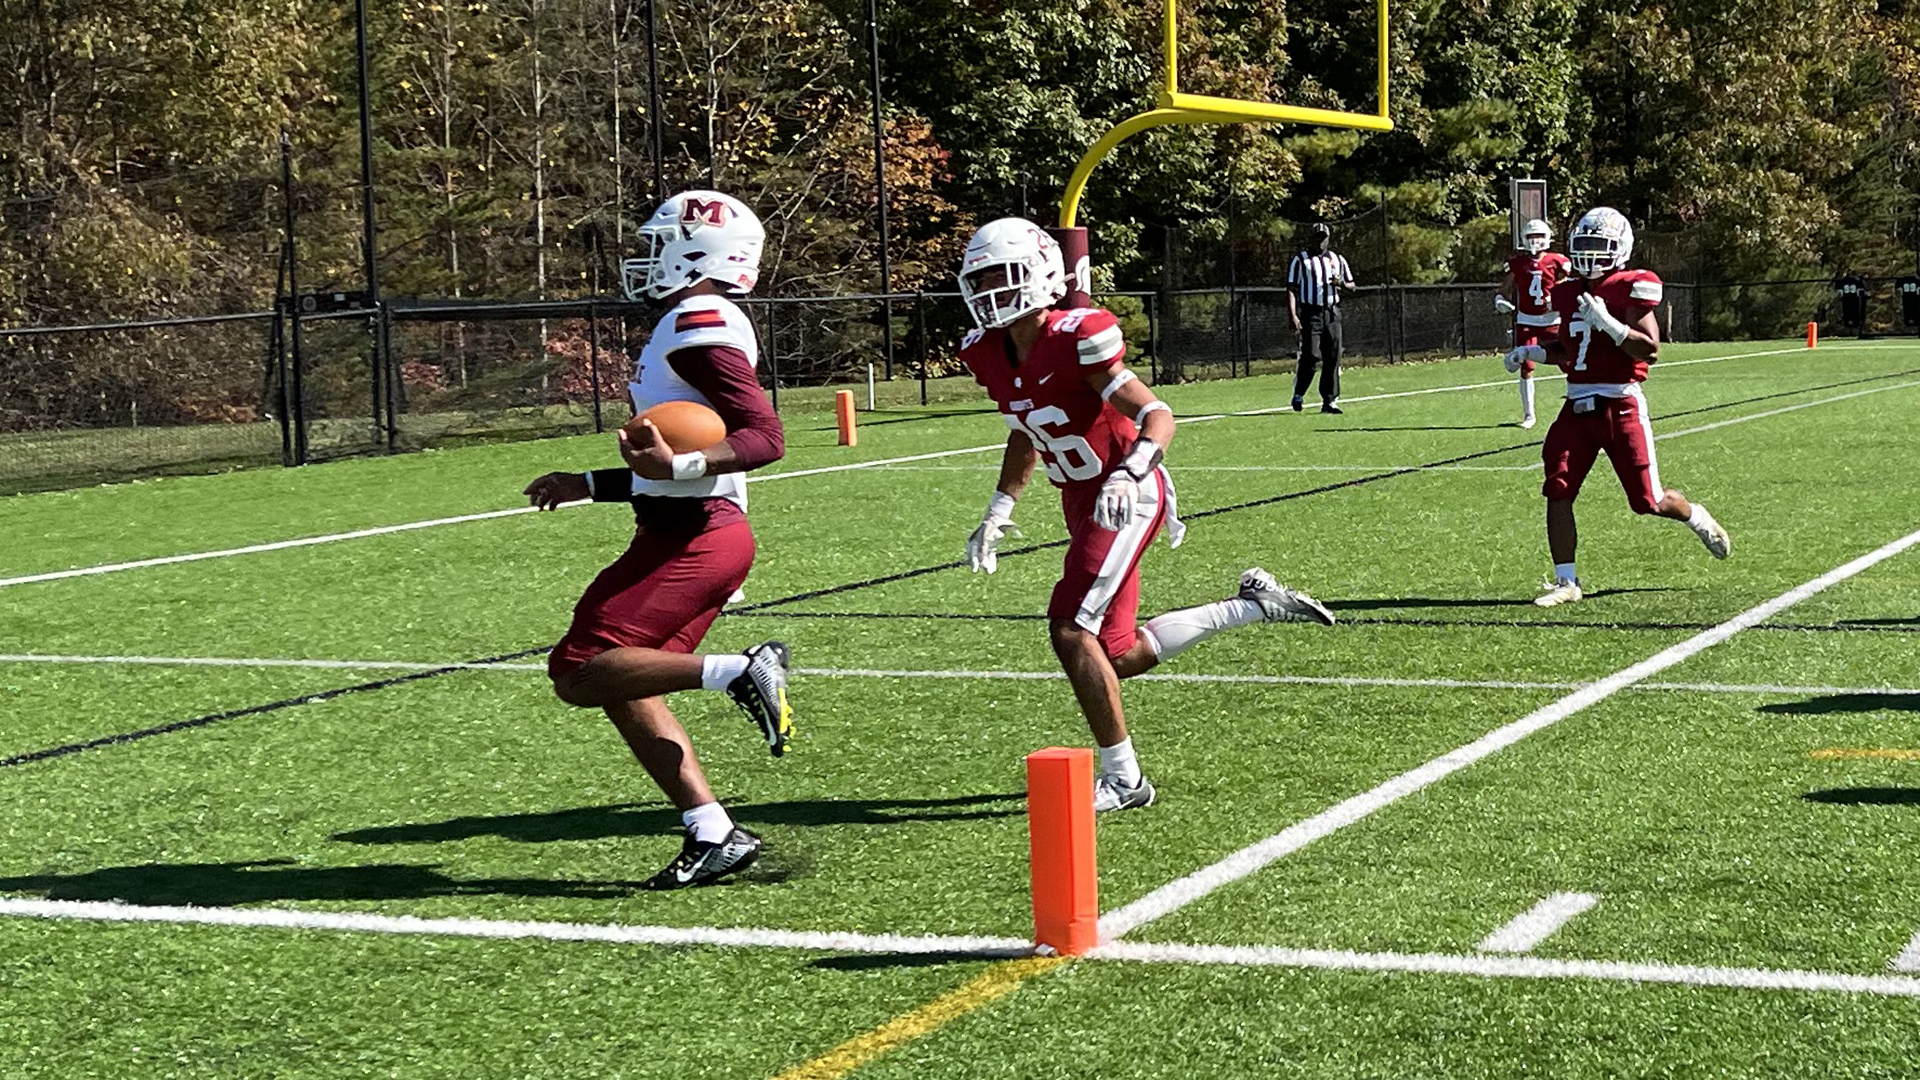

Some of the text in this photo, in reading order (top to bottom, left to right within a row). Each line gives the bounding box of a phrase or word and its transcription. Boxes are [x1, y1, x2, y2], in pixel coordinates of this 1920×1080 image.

[680, 198, 725, 228] M
[1529, 275, 1544, 305] 4
[1569, 321, 1591, 371] 7
[1004, 405, 1103, 483] 26
